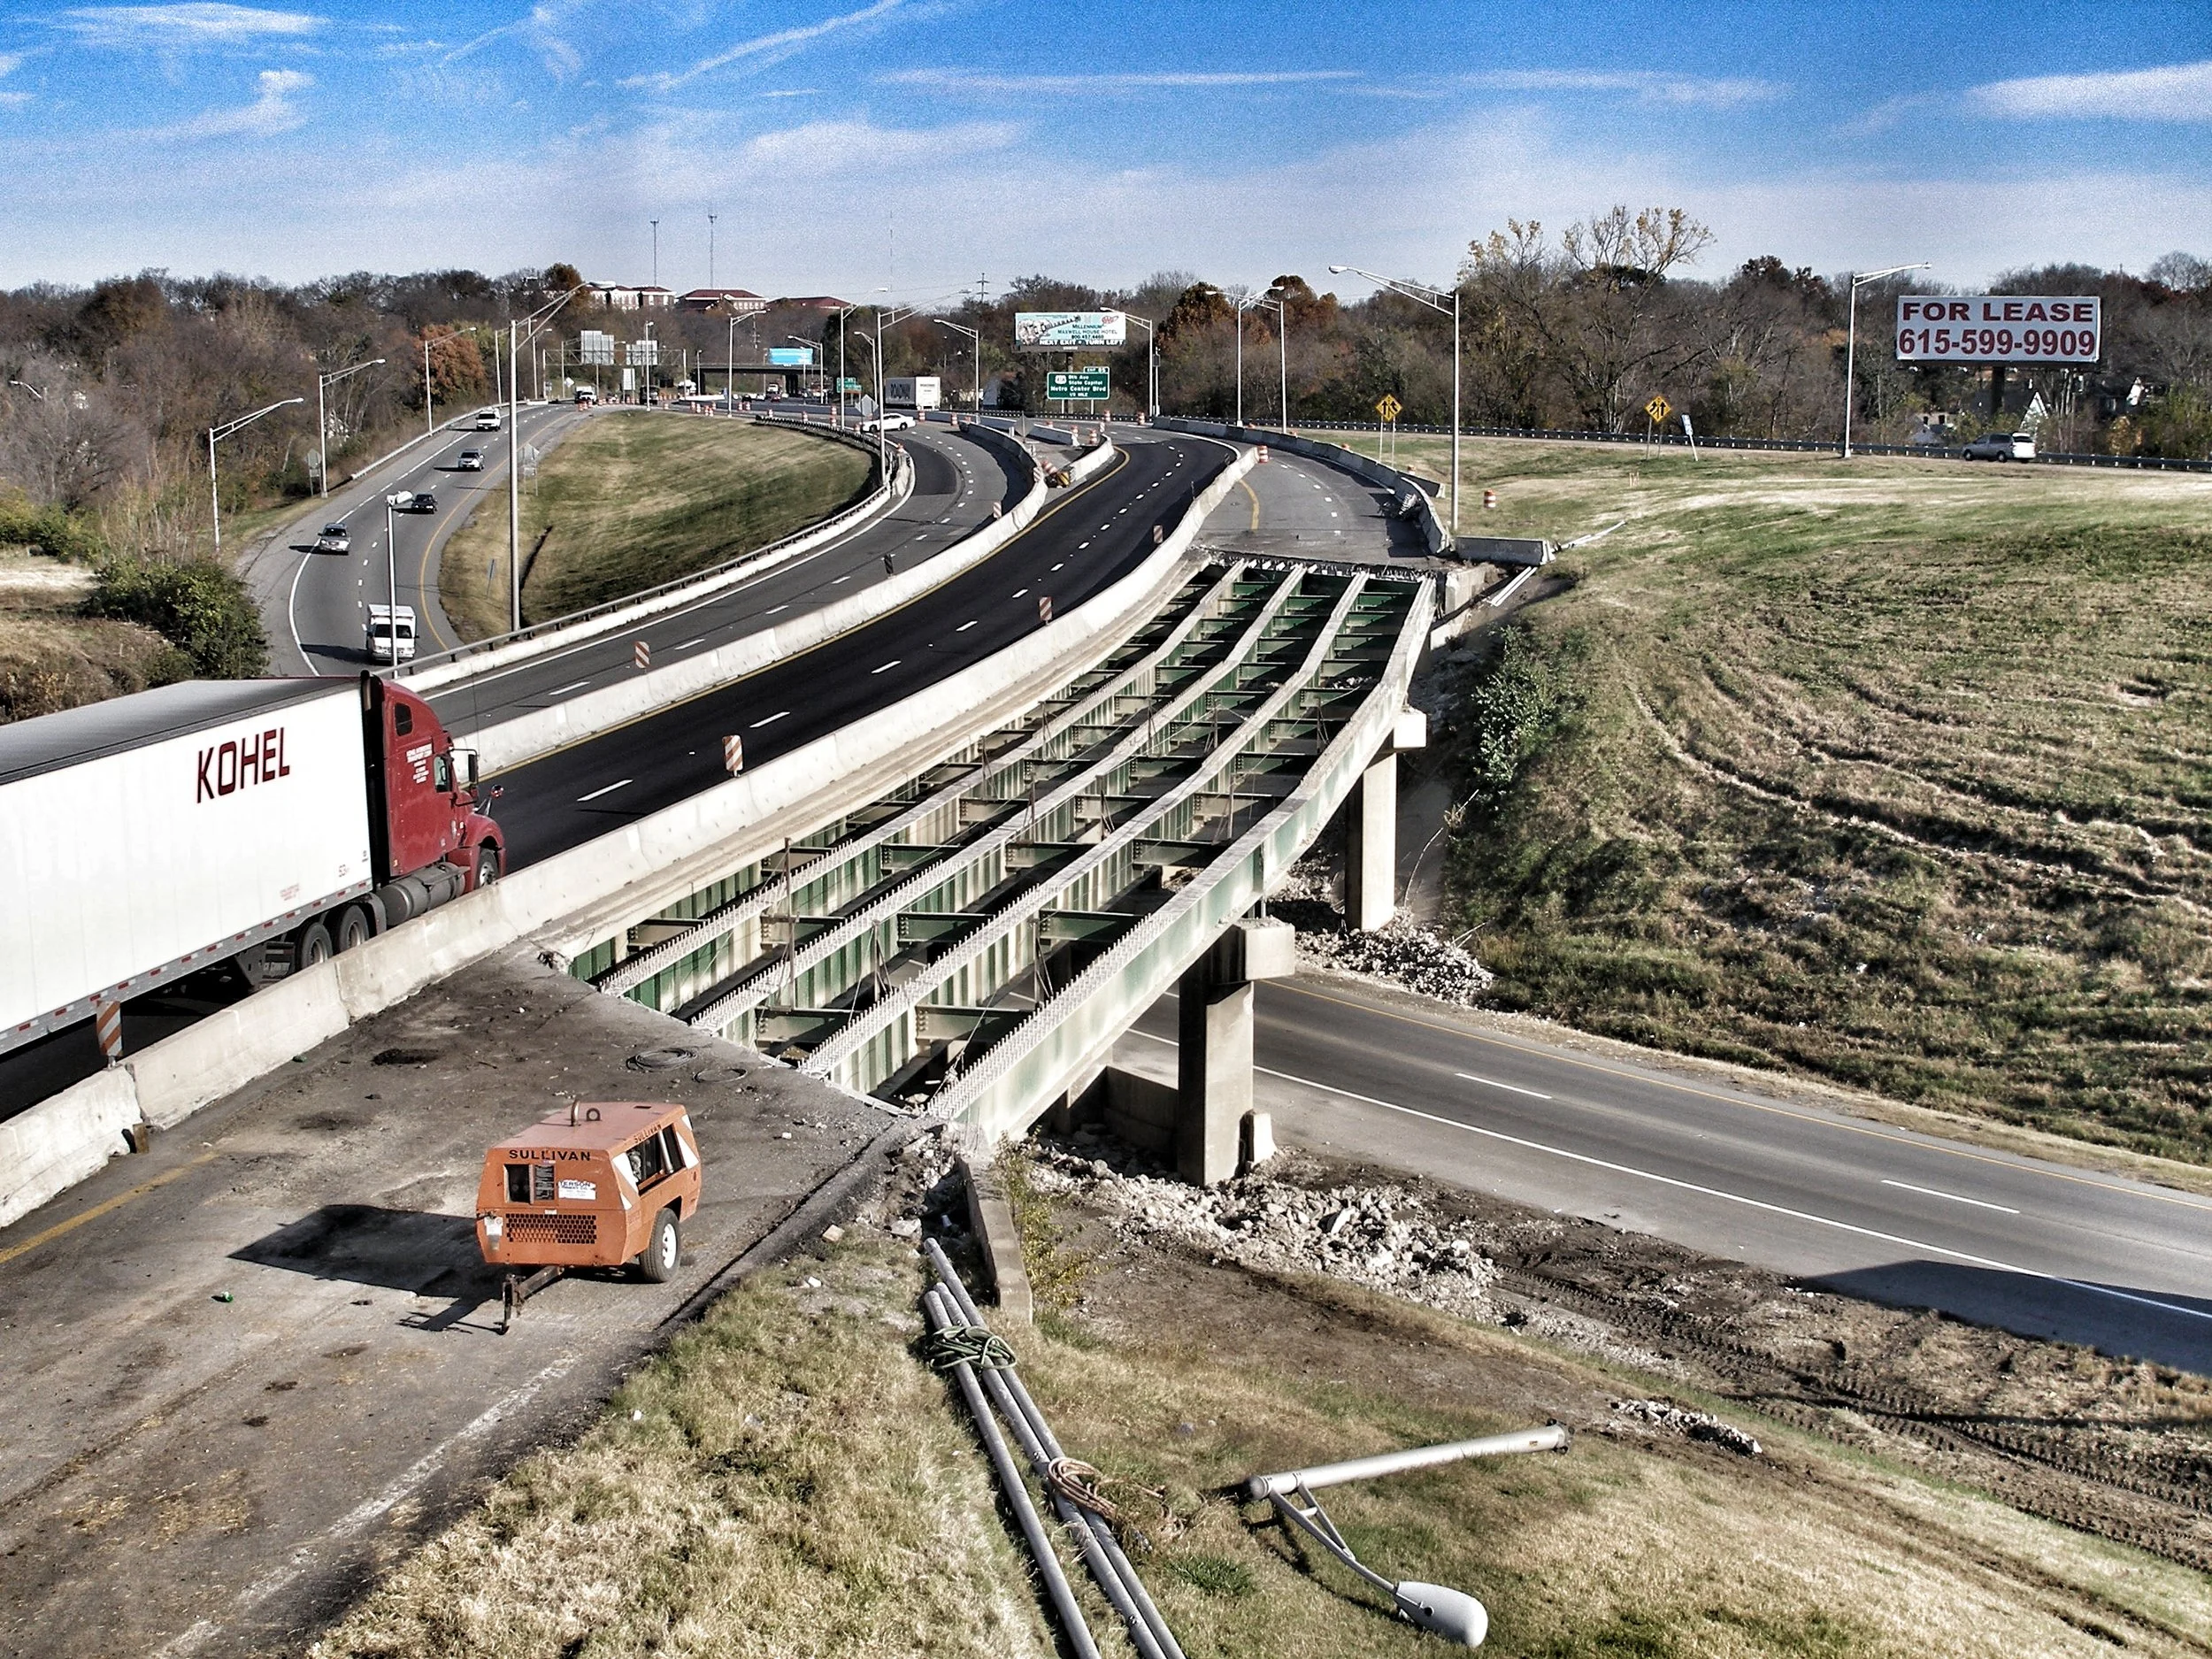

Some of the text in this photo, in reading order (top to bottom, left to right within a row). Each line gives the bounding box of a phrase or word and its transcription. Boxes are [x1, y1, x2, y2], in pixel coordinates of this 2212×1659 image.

[1902, 303, 2093, 322] FOR LEASE
[1899, 328, 2095, 357] 615-599-9909
[196, 726, 291, 804] KOHEL
[634, 1123, 663, 1143] SULLIVAN
[509, 1149, 591, 1162] SULLIVAN
